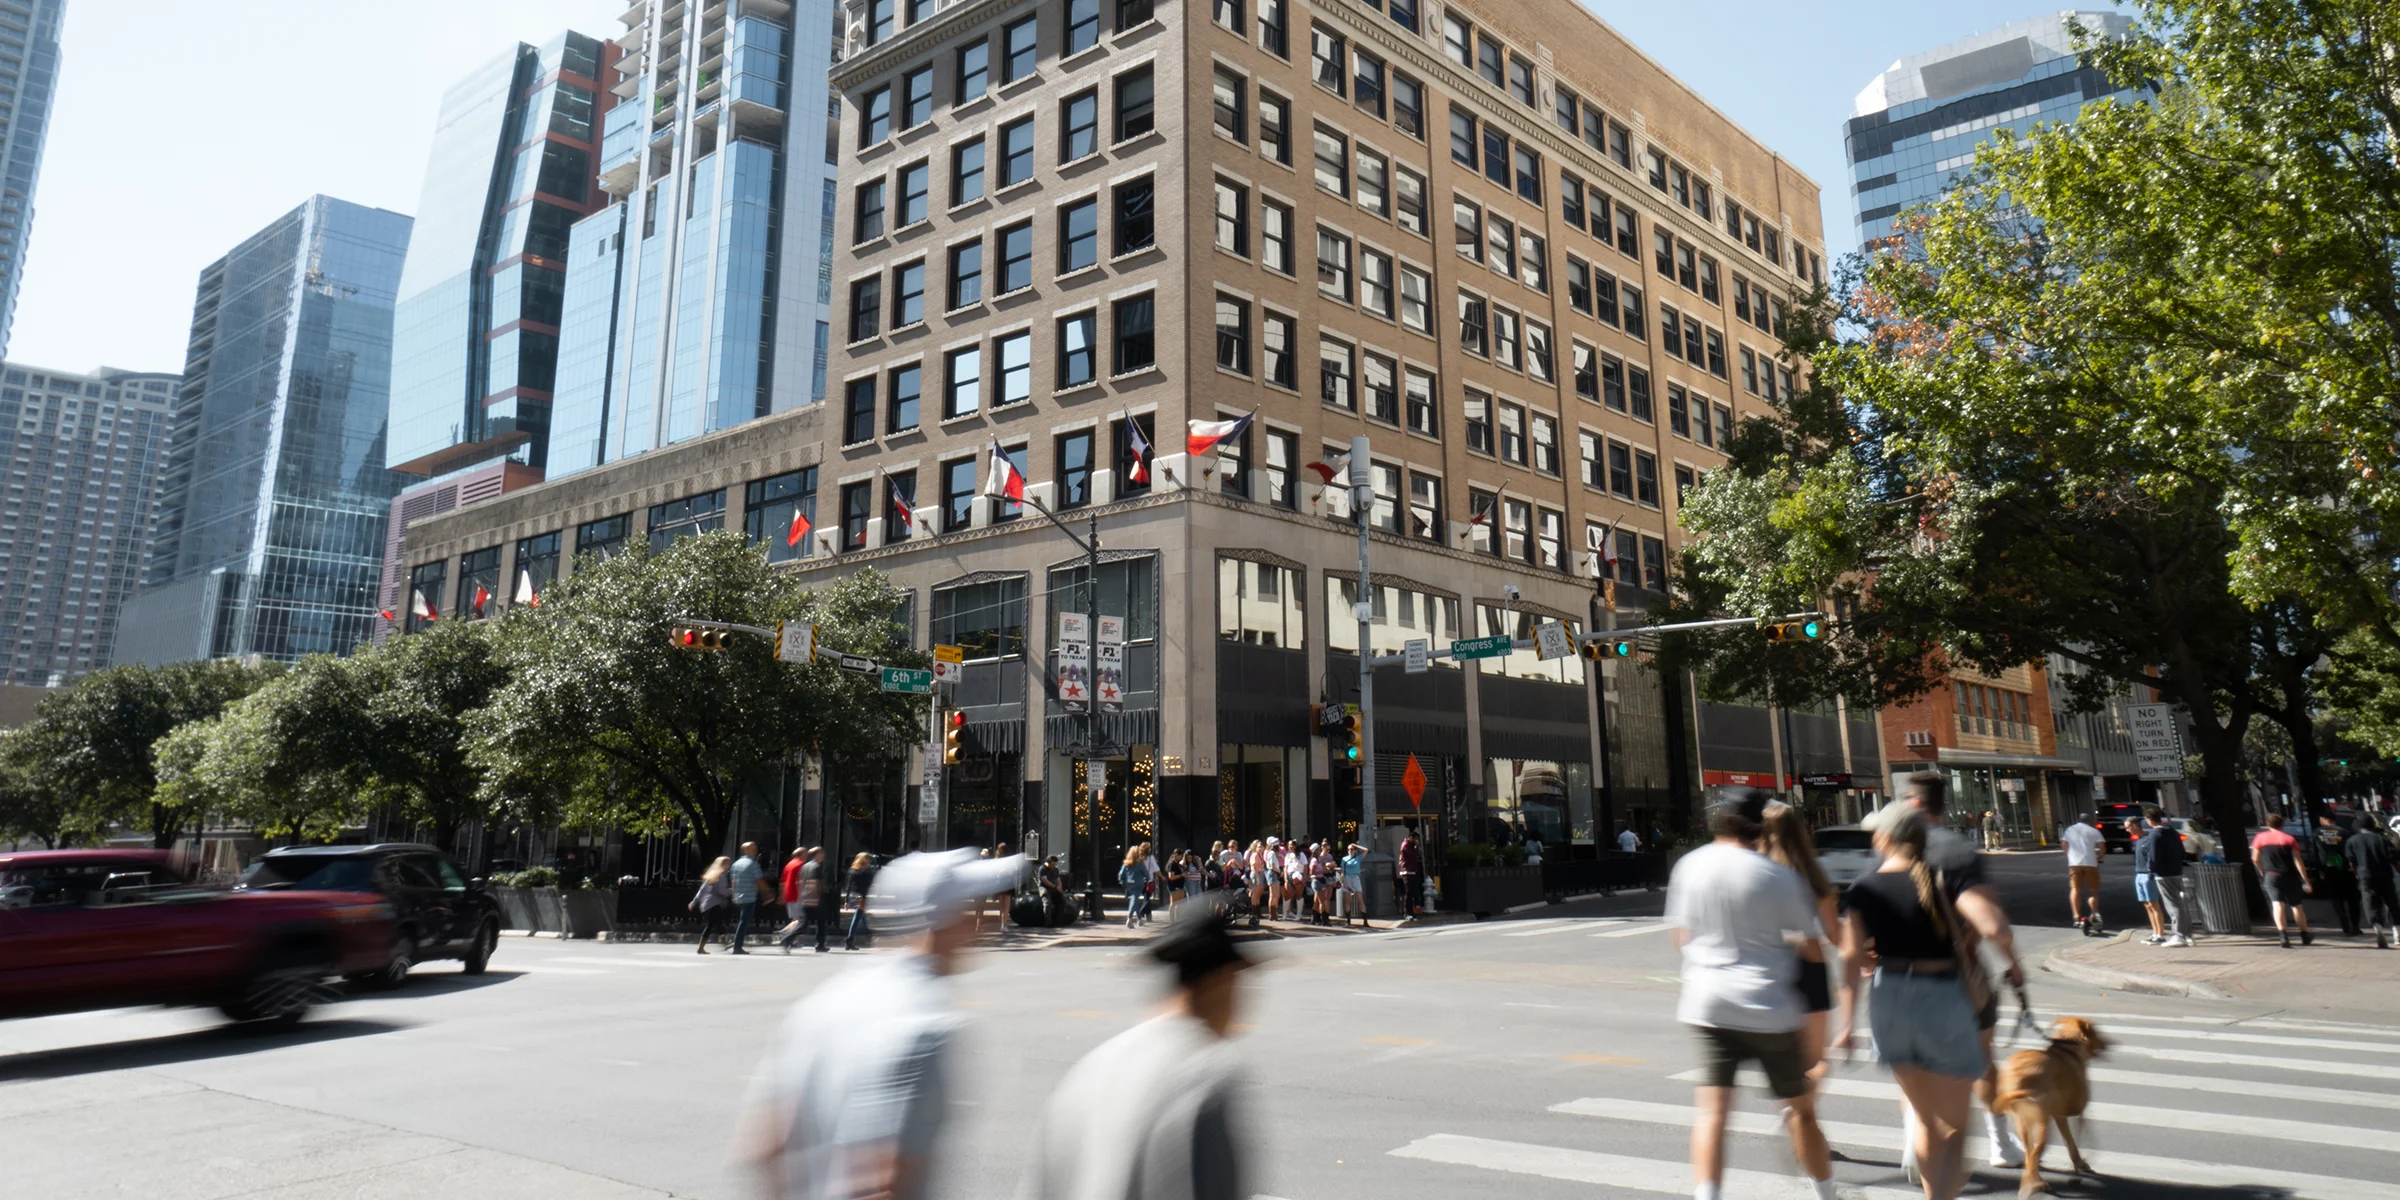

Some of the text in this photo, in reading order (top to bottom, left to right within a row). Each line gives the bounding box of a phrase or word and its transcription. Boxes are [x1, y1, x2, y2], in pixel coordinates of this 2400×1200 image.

[1548, 621, 1563, 629] BLOCK
[1454, 636, 1508, 652] Congress AVE
[1067, 644, 1080, 654] F1
[1103, 647, 1115, 657] F1
[843, 658, 854, 666] ONE
[892, 671, 922, 683] 6th ST
[2138, 708, 2156, 717] NO
[2136, 720, 2162, 728] RIGHT
[1904, 731, 1931, 746] 111
[2136, 739, 2171, 748] ON RED
[923, 800, 935, 808] MUST
